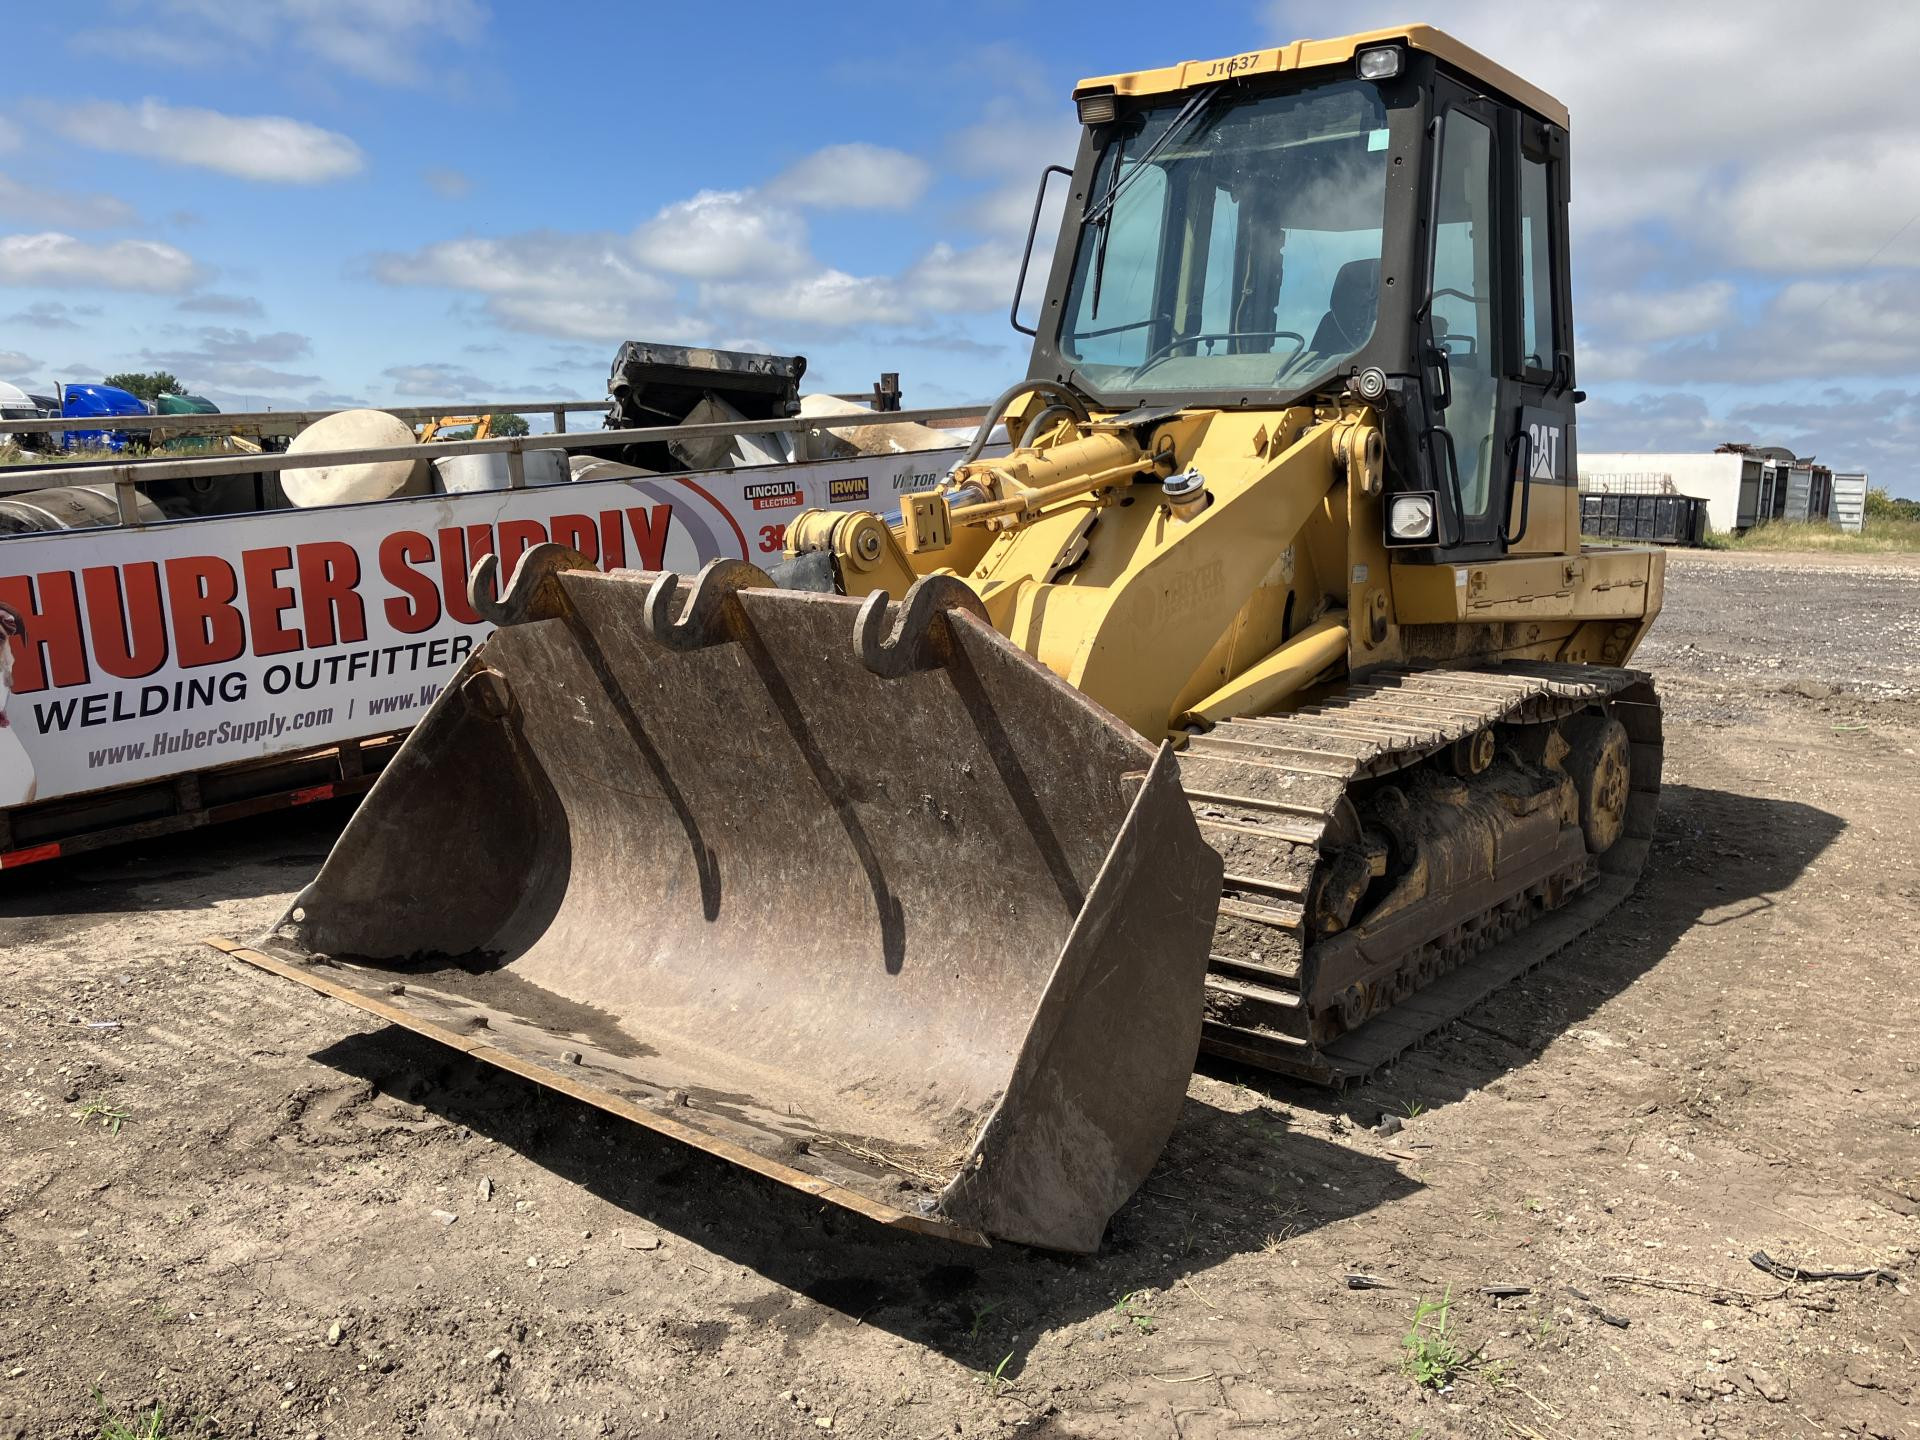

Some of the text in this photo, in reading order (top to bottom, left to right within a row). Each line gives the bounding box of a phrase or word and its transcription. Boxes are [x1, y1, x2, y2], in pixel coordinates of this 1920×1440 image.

[1529, 423, 1560, 480] CAT
[746, 483, 793, 499] LINCOLN
[831, 479, 867, 495] IRWIN
[892, 473, 937, 490] VITOR
[760, 496, 797, 508] ELECTRIC
[0, 541, 367, 695] HUBER
[33, 630, 496, 735] WELDING OUTFITTER
[88, 707, 334, 769] www.HuberSupply.com
